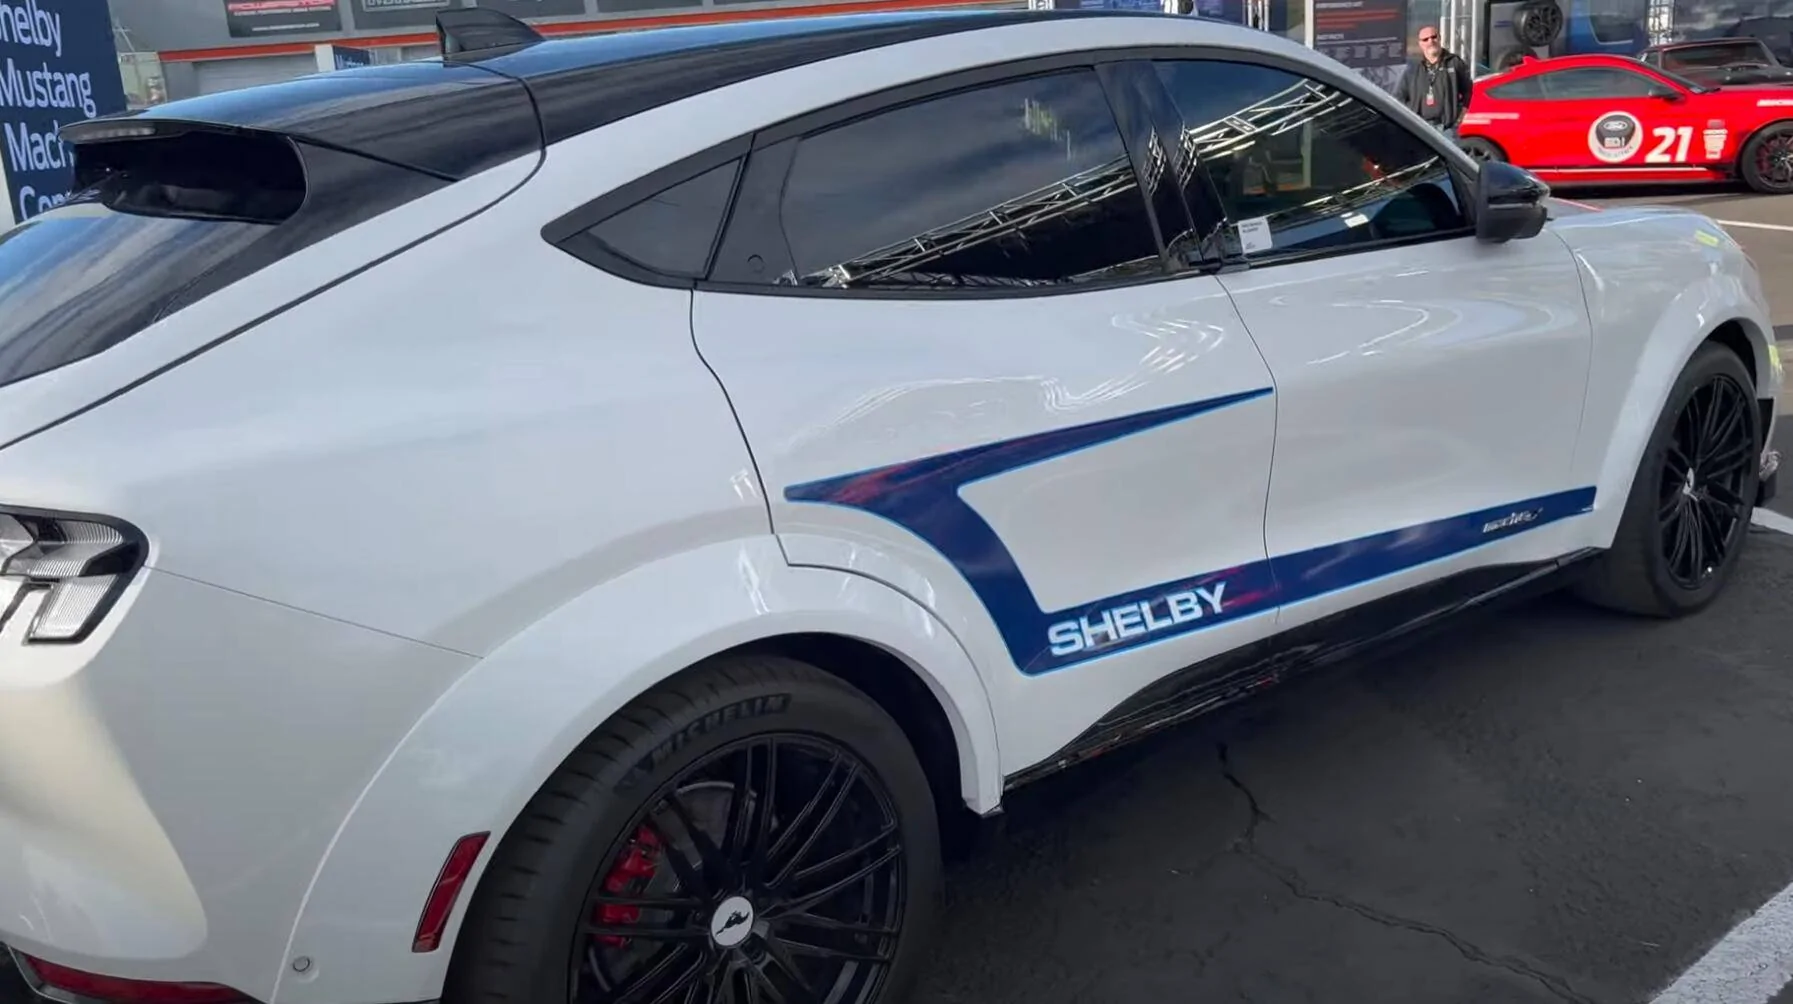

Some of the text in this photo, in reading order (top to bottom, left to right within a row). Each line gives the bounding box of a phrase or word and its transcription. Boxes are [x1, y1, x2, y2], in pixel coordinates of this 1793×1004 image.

[0, 0, 62, 57] helby
[0, 57, 97, 119] Mustang
[1644, 126, 1694, 163] 21
[1047, 581, 1227, 657] SHELBY
[650, 694, 789, 761] MICHELIN
